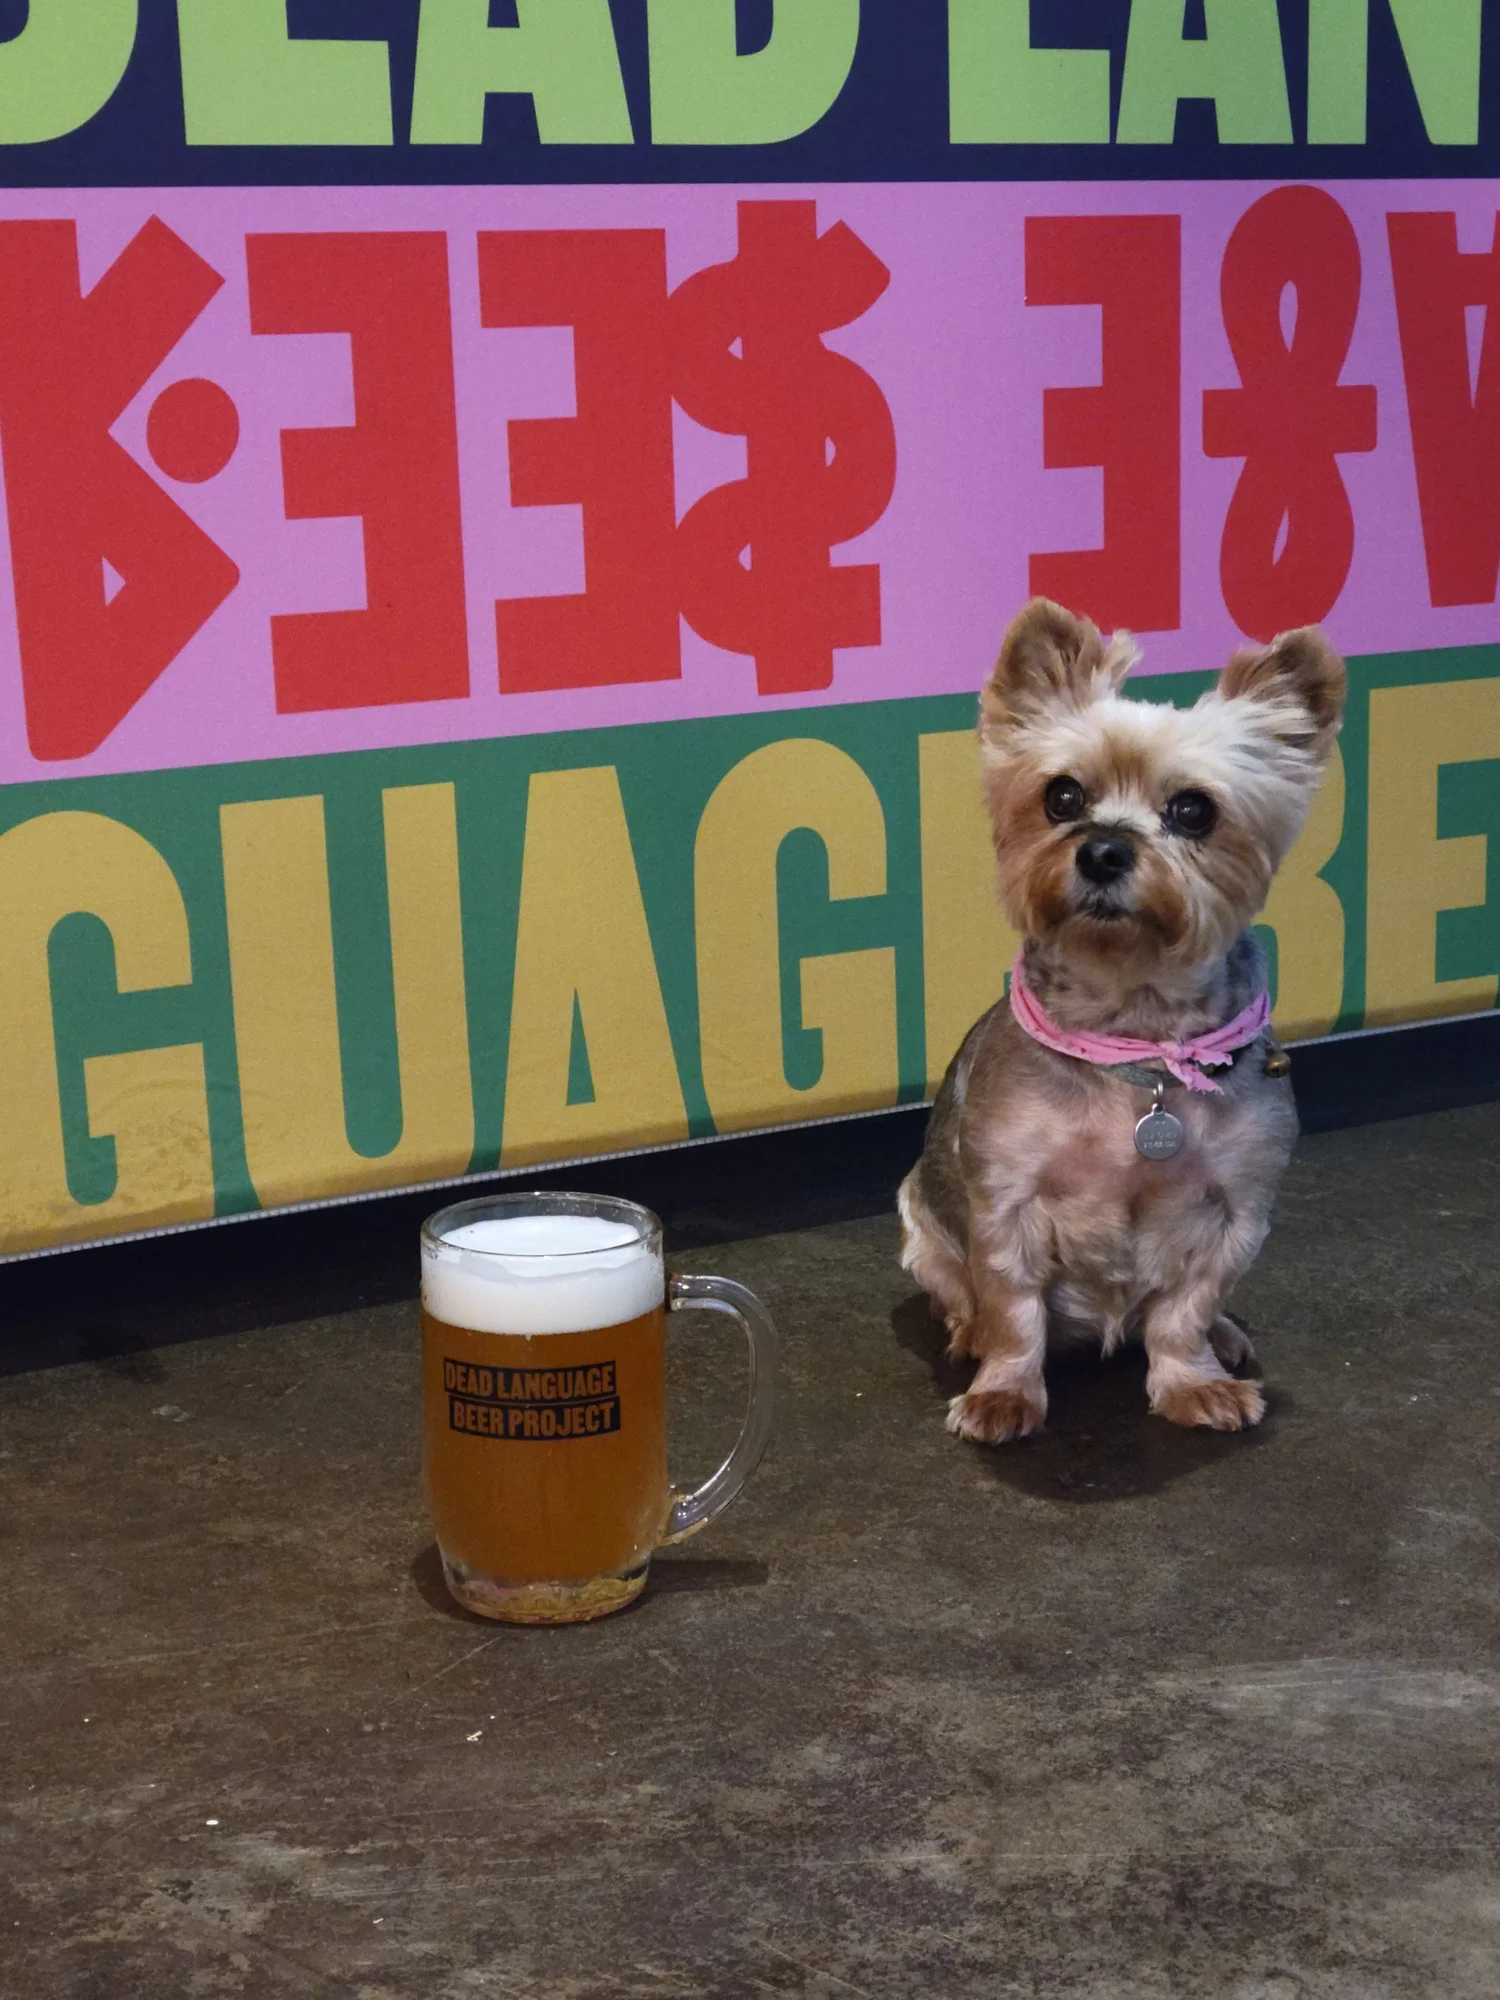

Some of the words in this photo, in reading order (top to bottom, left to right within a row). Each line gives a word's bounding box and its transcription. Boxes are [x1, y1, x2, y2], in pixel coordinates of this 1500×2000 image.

[445, 1361, 493, 1397] DEAD
[497, 1365, 614, 1400] LANGUAGE
[453, 1400, 504, 1436] BEER
[508, 1401, 615, 1437] PROJECT
